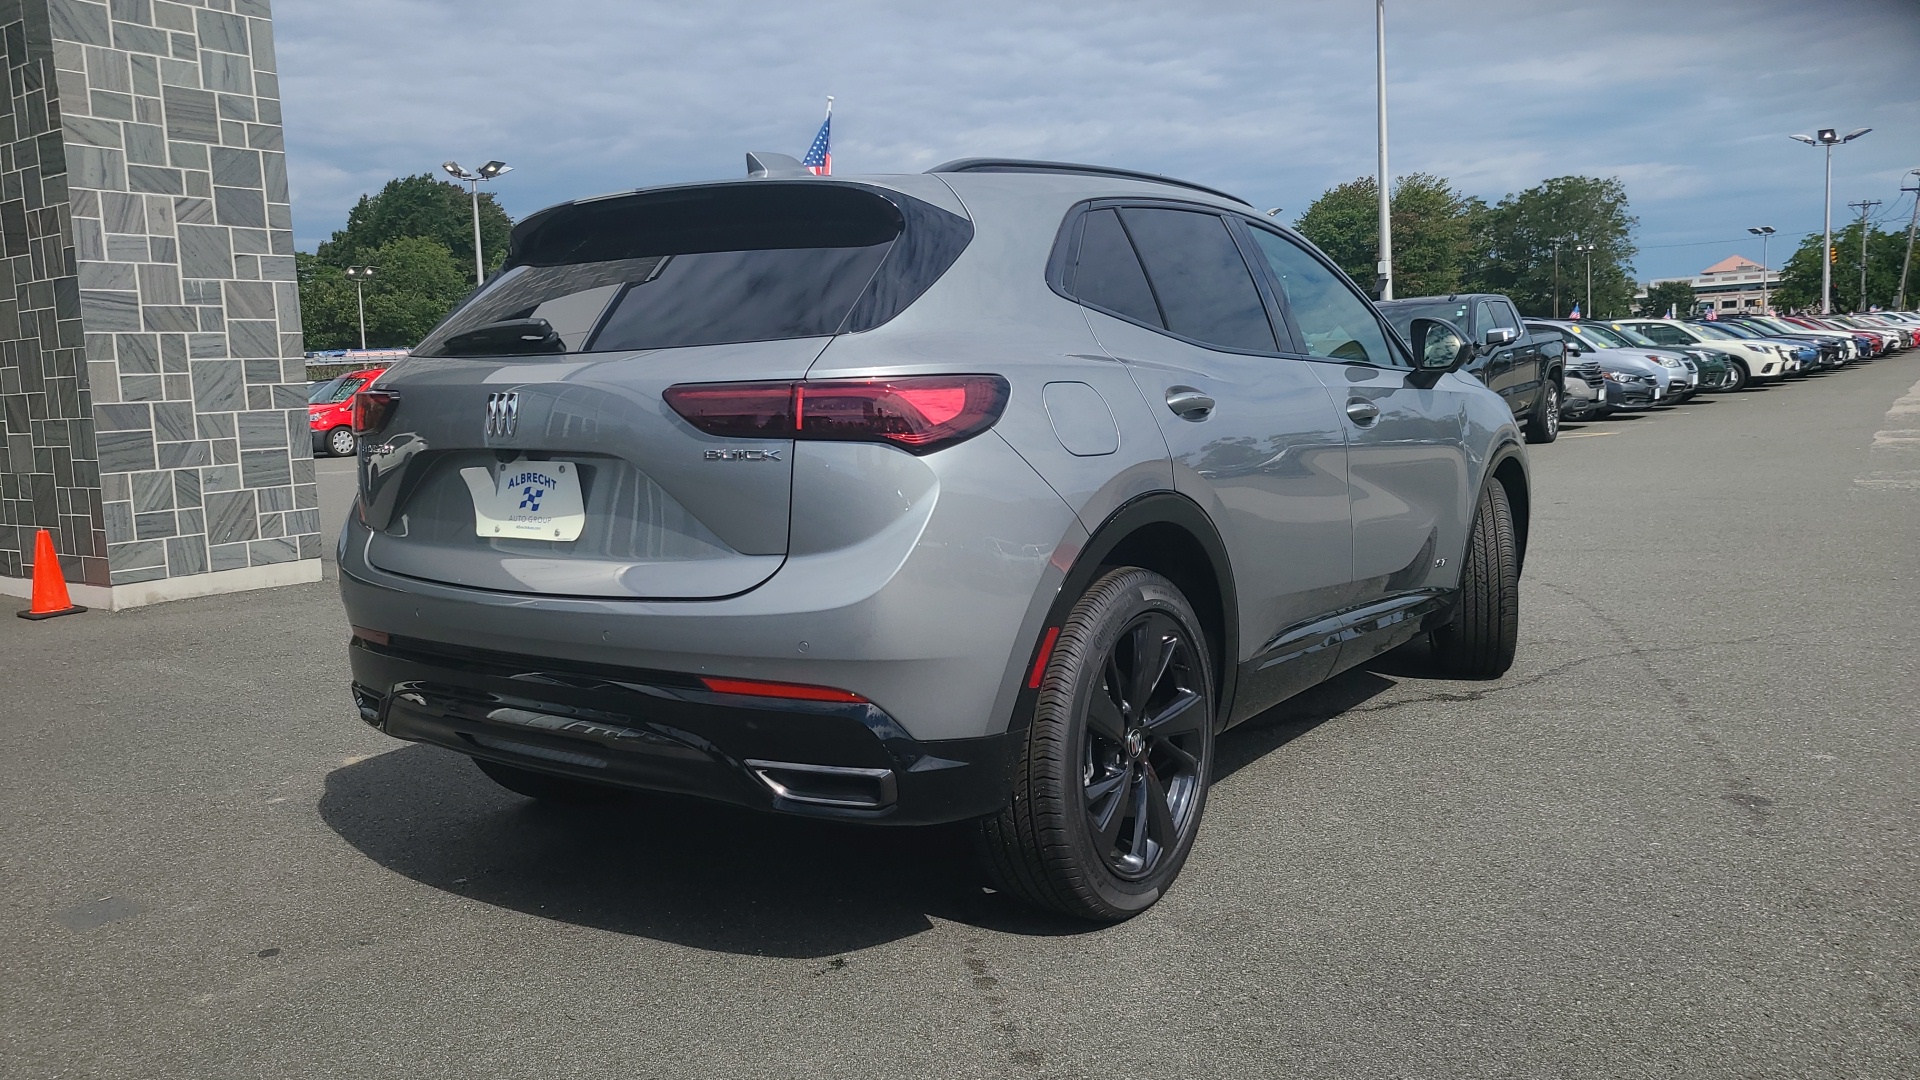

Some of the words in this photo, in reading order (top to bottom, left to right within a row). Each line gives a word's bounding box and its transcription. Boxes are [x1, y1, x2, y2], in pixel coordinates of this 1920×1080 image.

[704, 449, 782, 461] BUICK
[507, 472, 557, 490] ALBRECHT
[527, 515, 552, 524] GROUP
